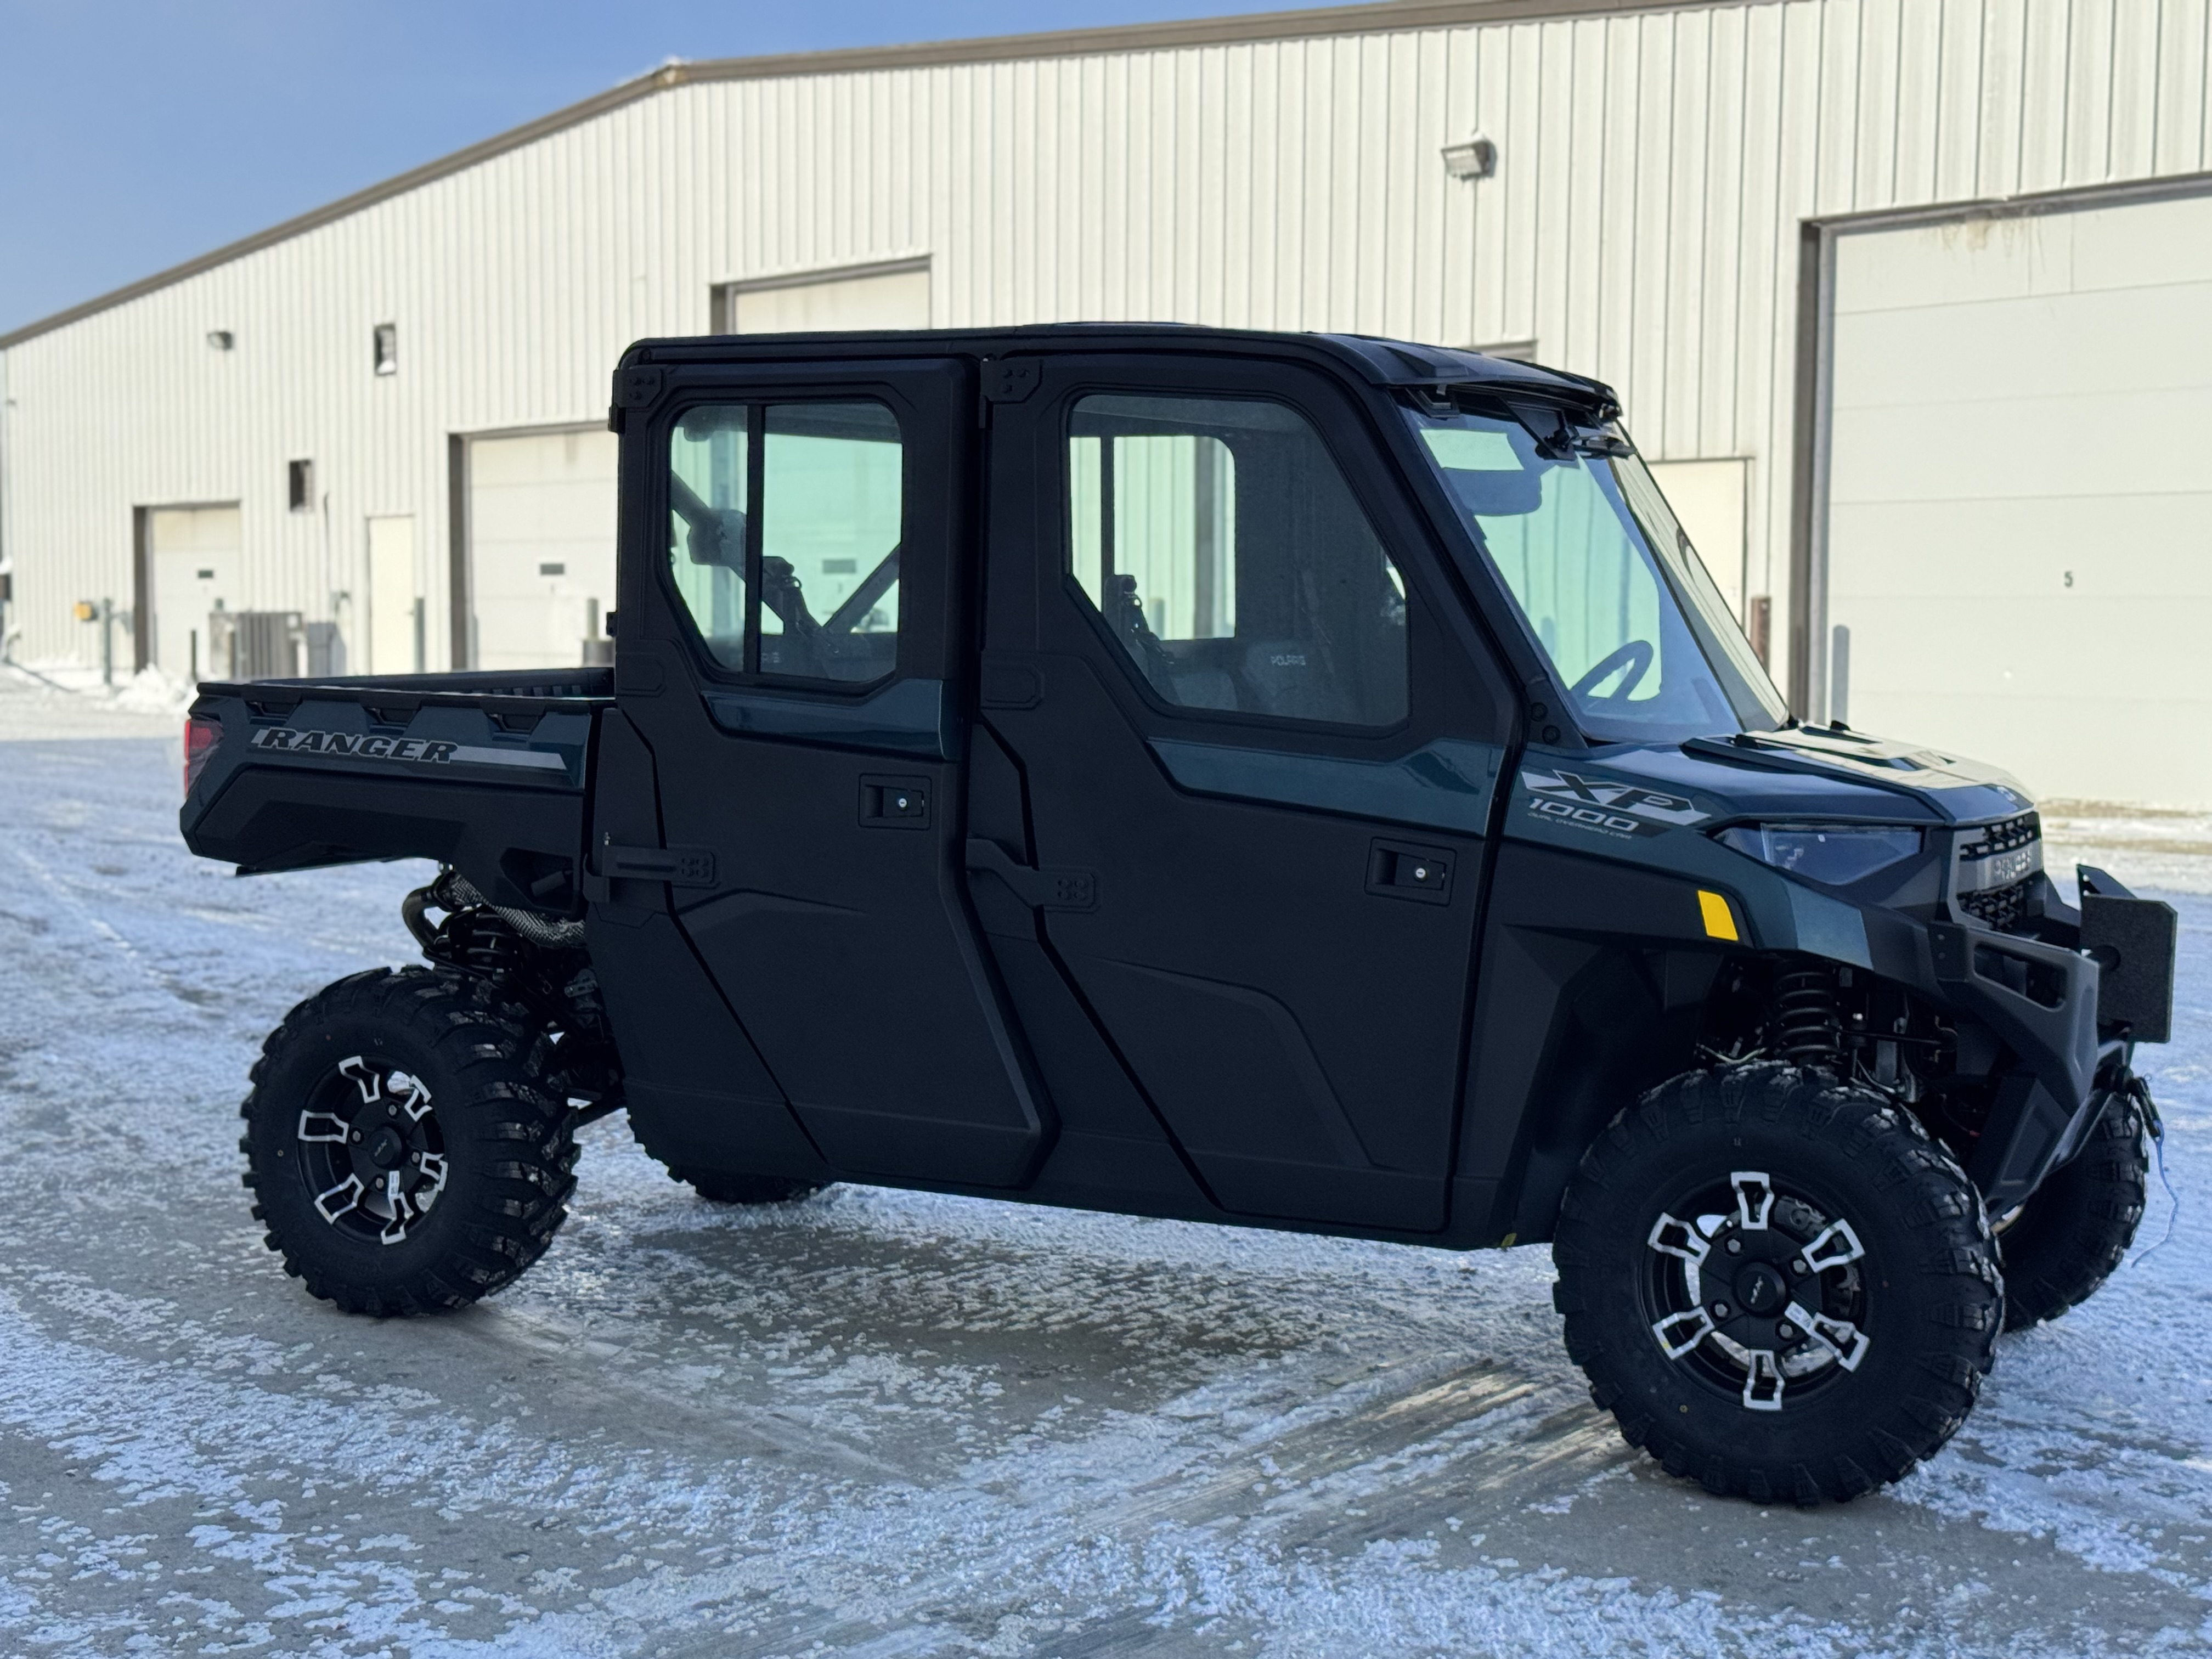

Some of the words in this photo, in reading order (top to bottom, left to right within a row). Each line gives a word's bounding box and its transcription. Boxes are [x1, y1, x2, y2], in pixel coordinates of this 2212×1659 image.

[2064, 571, 2073, 588] 5
[259, 726, 459, 764] RANGER
[1521, 769, 1712, 826] XP
[1529, 798, 1639, 832] 1000
